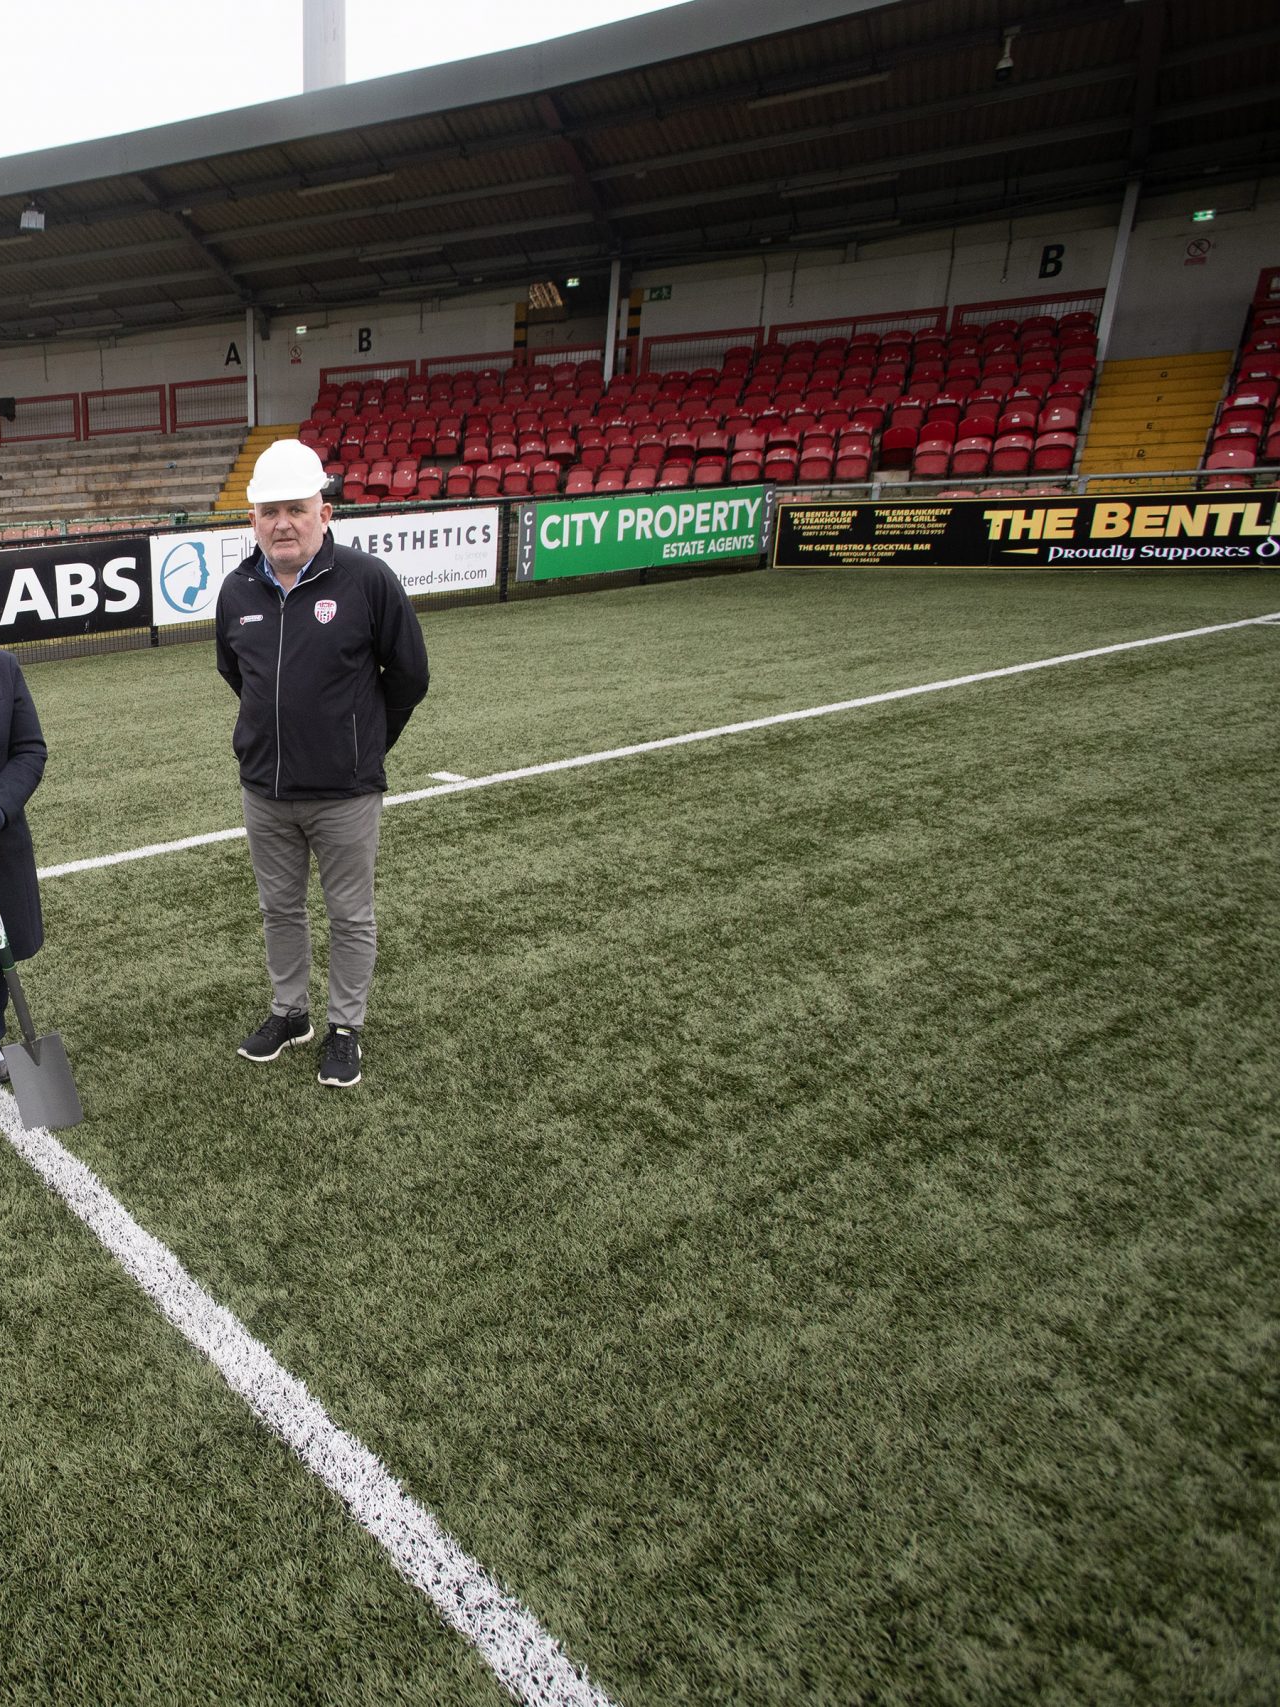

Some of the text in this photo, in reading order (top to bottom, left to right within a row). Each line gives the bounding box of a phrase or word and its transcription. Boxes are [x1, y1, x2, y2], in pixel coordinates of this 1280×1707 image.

[1039, 244, 1064, 278] B
[358, 328, 372, 352] B
[224, 341, 241, 365] A
[540, 497, 762, 549] CITY PROPERTY
[806, 510, 840, 518] BENTLEY
[891, 508, 953, 516] EMBANKMENT
[983, 508, 1078, 540] THE
[351, 525, 491, 554] AESTHETICS
[662, 535, 755, 559] ESTATE AGENTS
[1048, 544, 1135, 562] Proudly
[1140, 545, 1250, 560] Supports
